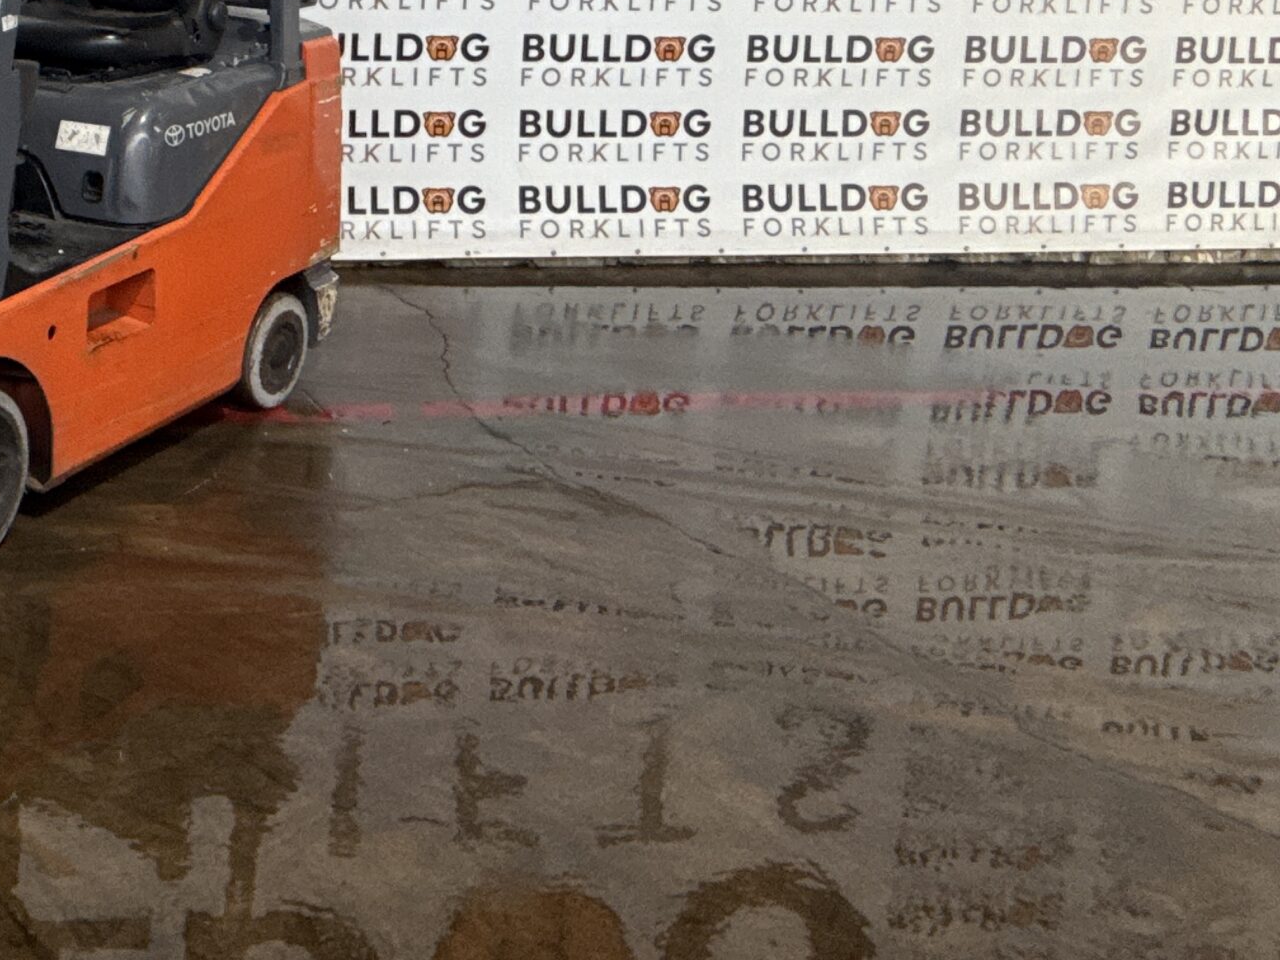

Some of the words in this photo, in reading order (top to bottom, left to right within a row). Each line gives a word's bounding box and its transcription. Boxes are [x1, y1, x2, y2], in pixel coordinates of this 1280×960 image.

[522, 33, 716, 63] BULLDG
[747, 34, 935, 64] BULLDG
[964, 36, 1147, 64] BULLDG
[521, 67, 712, 87] FORKLIFTS
[745, 68, 931, 87] FORKLIFTS
[963, 69, 1143, 87] FORKLIFTS
[185, 111, 236, 139] TOYOTA
[519, 109, 711, 138] BULLDG
[743, 109, 930, 138] BULLDG
[960, 109, 1141, 137] BULLDG
[519, 143, 709, 162] FORKLIFTS
[742, 142, 927, 161] FORKLIFTS
[960, 141, 1138, 161] FORKLIFTS
[519, 184, 711, 214] BULLDG
[742, 182, 928, 213] BULLDG
[959, 182, 1139, 211] BULLDG
[520, 218, 711, 238] FORKLIFTS
[743, 217, 928, 237] FORKLIFTS
[959, 214, 1136, 234] FORKLIFTS
